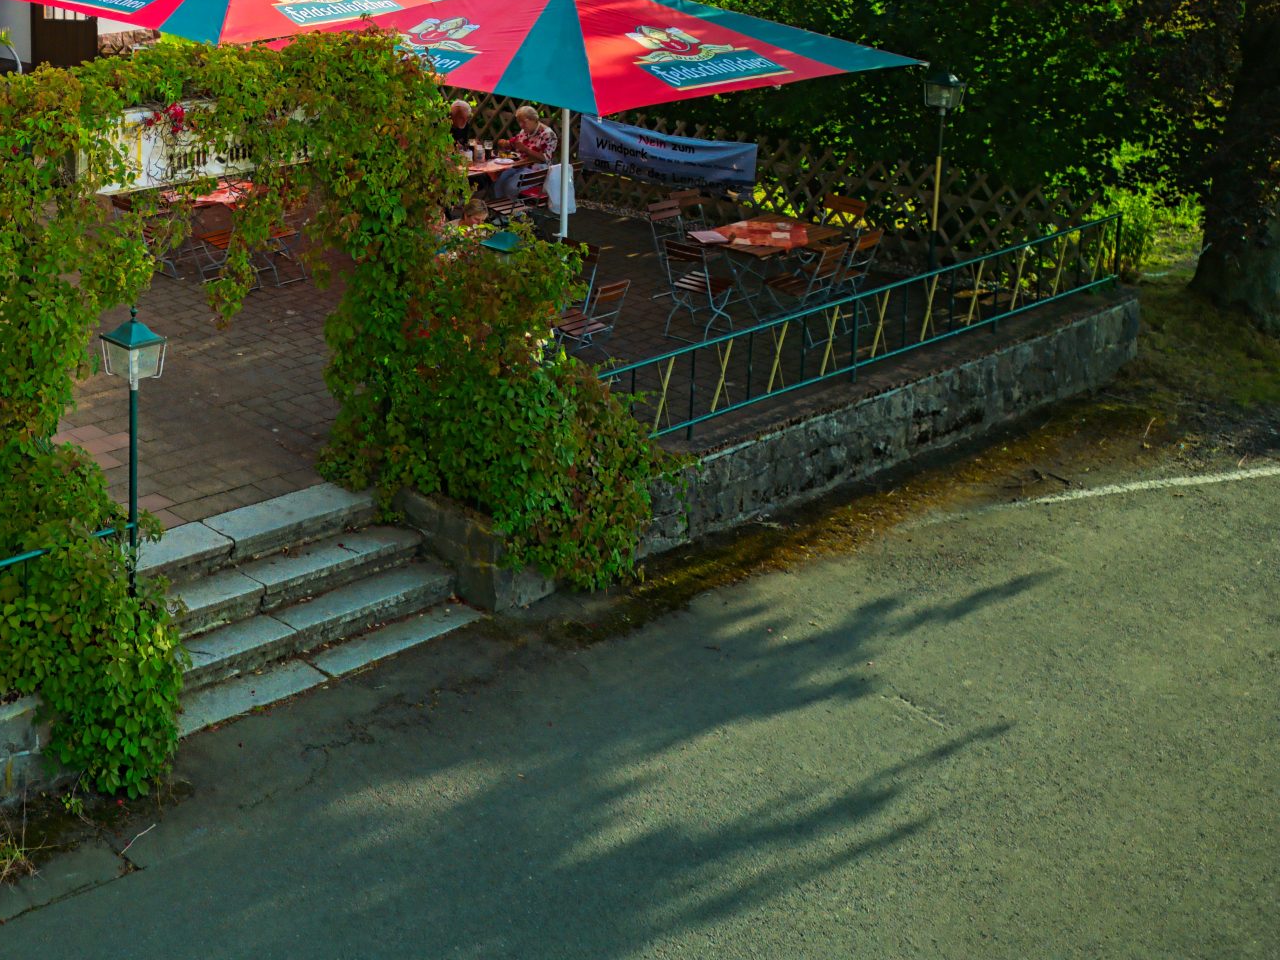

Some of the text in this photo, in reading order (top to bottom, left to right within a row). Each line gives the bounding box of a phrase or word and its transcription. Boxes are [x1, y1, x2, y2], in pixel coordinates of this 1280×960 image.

[650, 56, 777, 86] Feldschlößchen
[595, 136, 648, 160] Windpark
[638, 133, 696, 155] Nein zum
[594, 158, 610, 169] am
